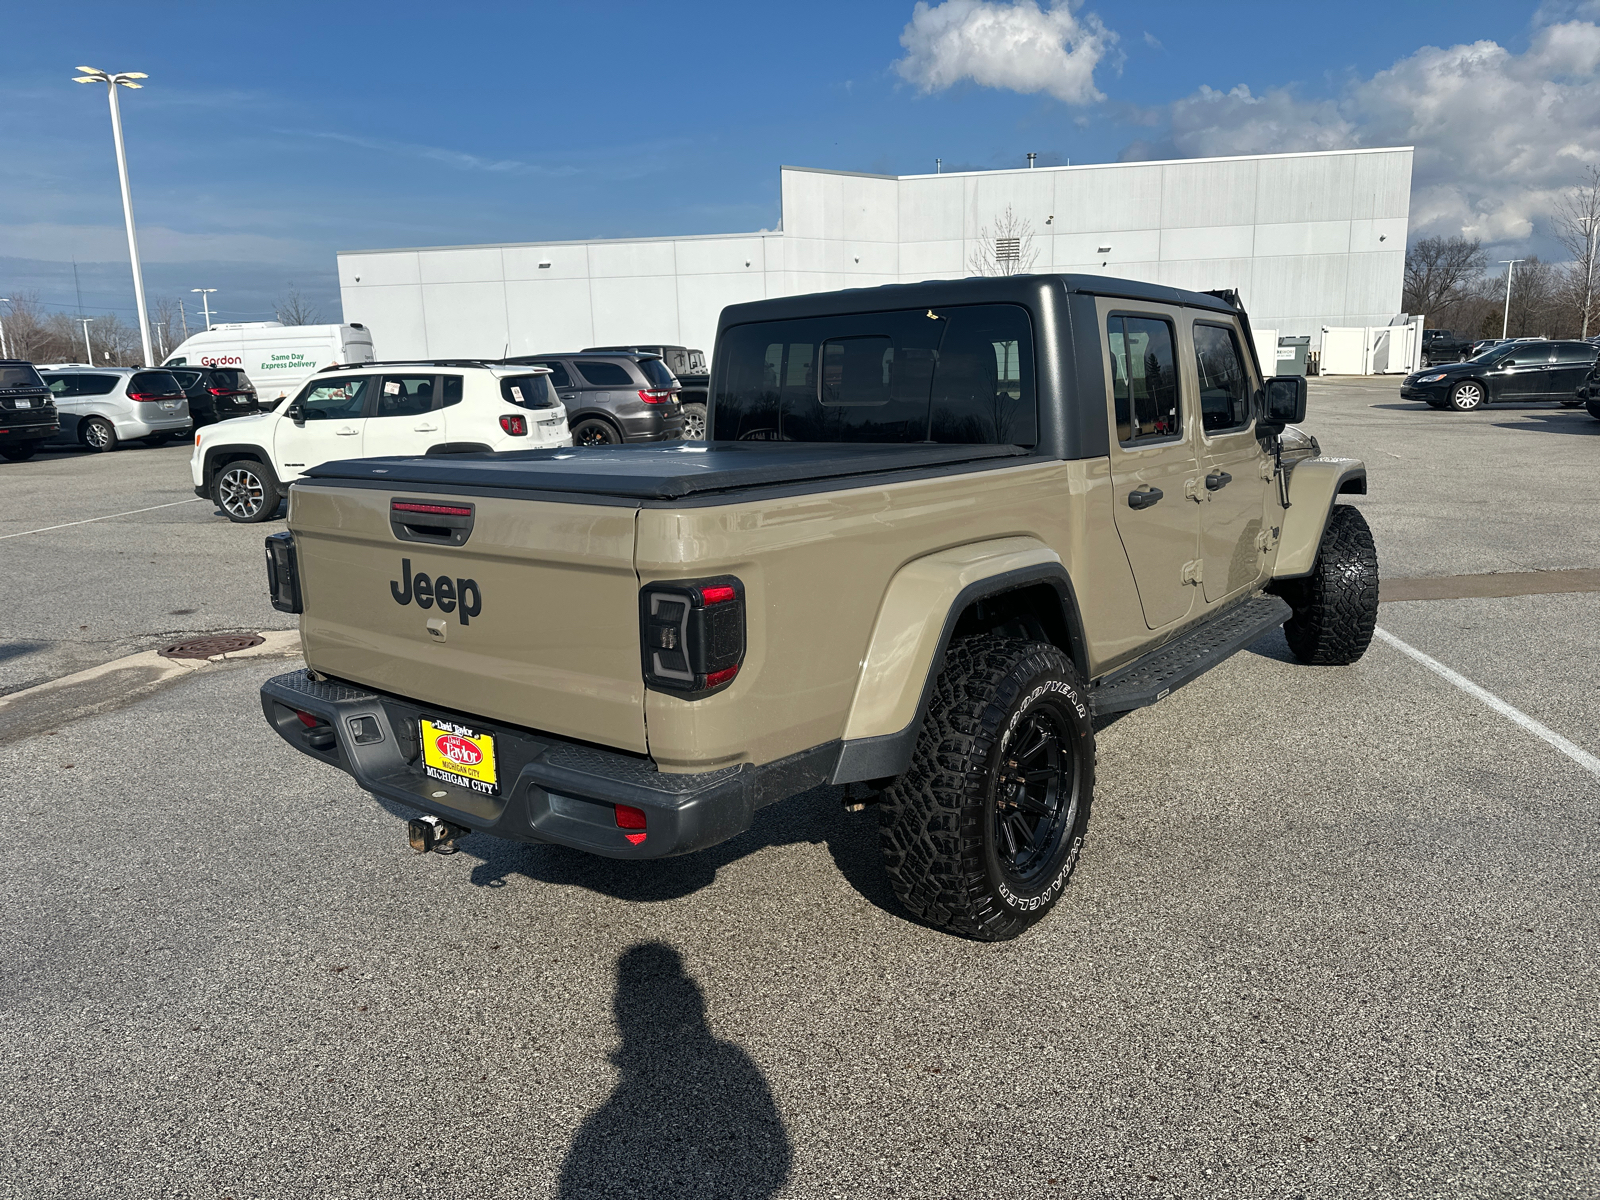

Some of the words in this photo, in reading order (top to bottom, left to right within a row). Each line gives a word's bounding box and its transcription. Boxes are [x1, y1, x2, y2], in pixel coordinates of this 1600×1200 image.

[201, 356, 242, 367] Gordon
[261, 362, 287, 370] Express
[289, 360, 317, 368] Delivery
[291, 353, 304, 362] Day
[390, 558, 482, 626] Jeep
[436, 720, 453, 731] David
[1001, 681, 1086, 752] GOODYEAR
[447, 736, 461, 746] David
[443, 742, 478, 763] Taylor
[442, 760, 467, 774] MICHIGAN
[468, 769, 480, 778] CITY
[427, 766, 470, 788] MICHIGAN
[471, 780, 493, 795] CITY
[998, 836, 1082, 911] WRANGLER
